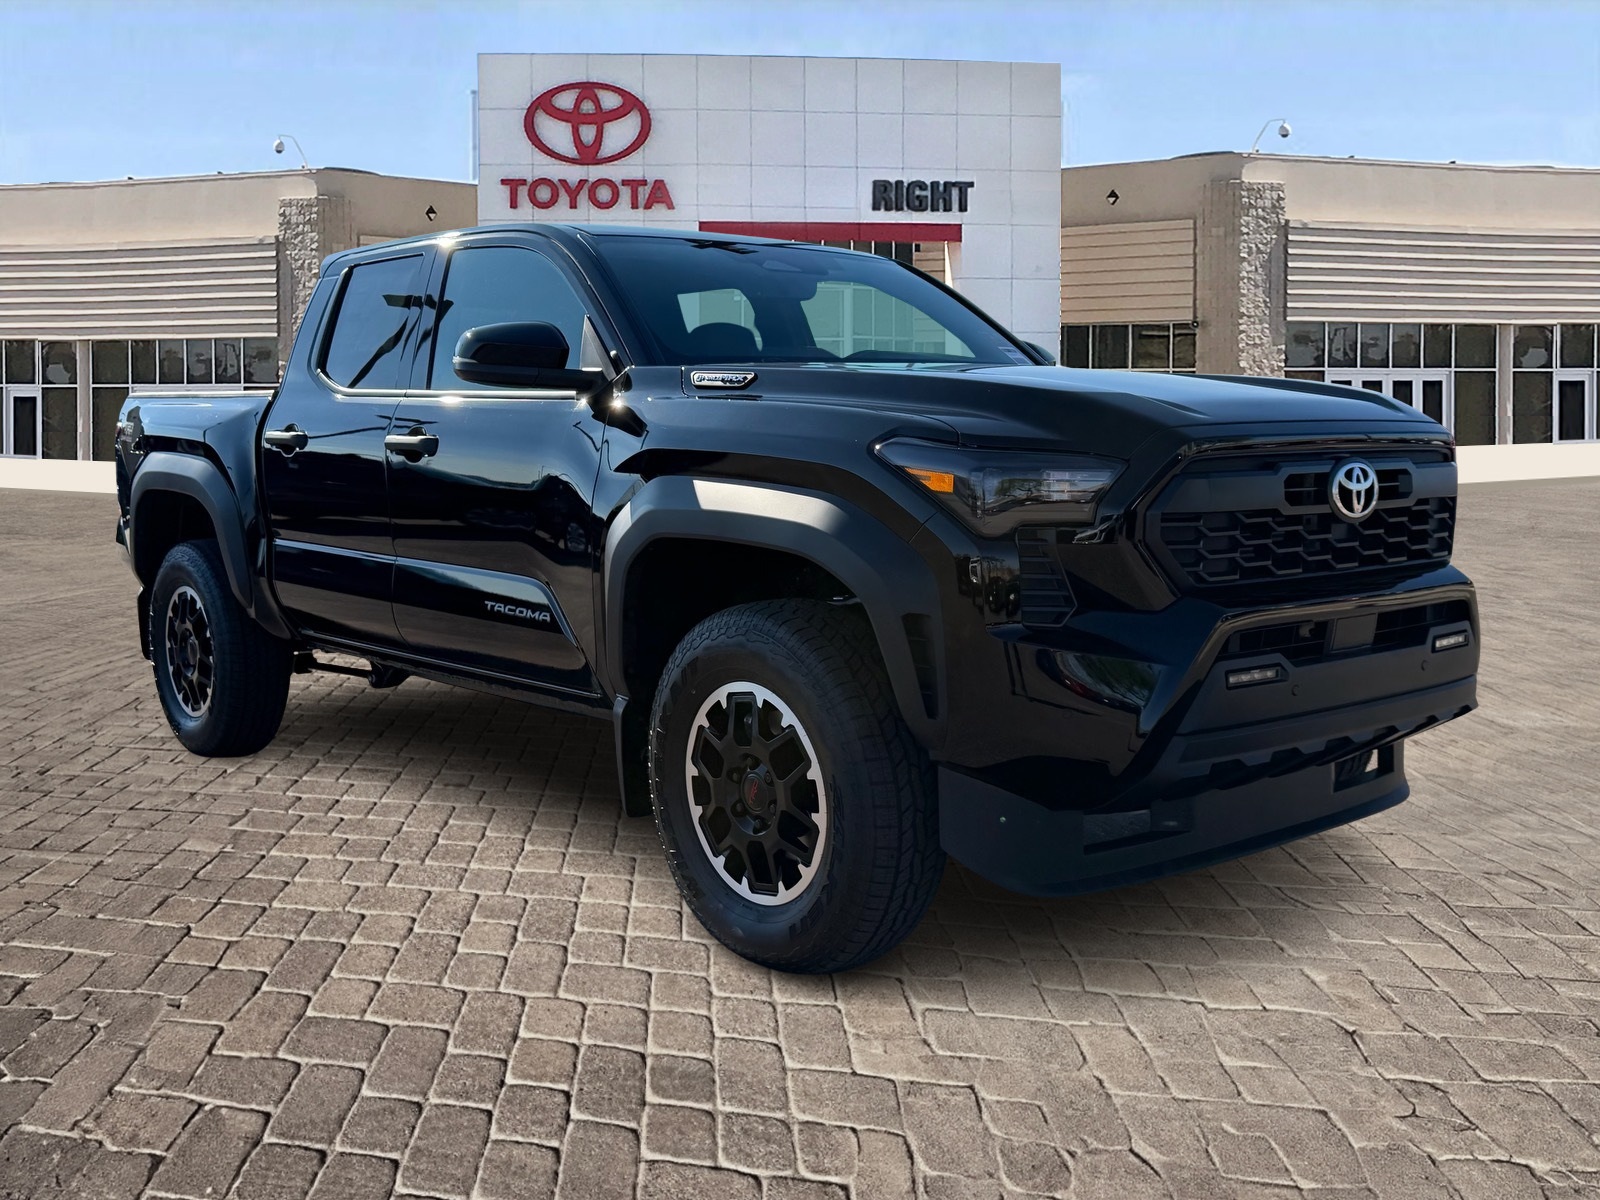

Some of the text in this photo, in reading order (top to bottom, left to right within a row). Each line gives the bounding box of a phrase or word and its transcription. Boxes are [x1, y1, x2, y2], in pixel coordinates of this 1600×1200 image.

[500, 178, 675, 210] TOYOTA
[871, 179, 975, 213] RIGHT
[484, 600, 551, 623] TACOMA
